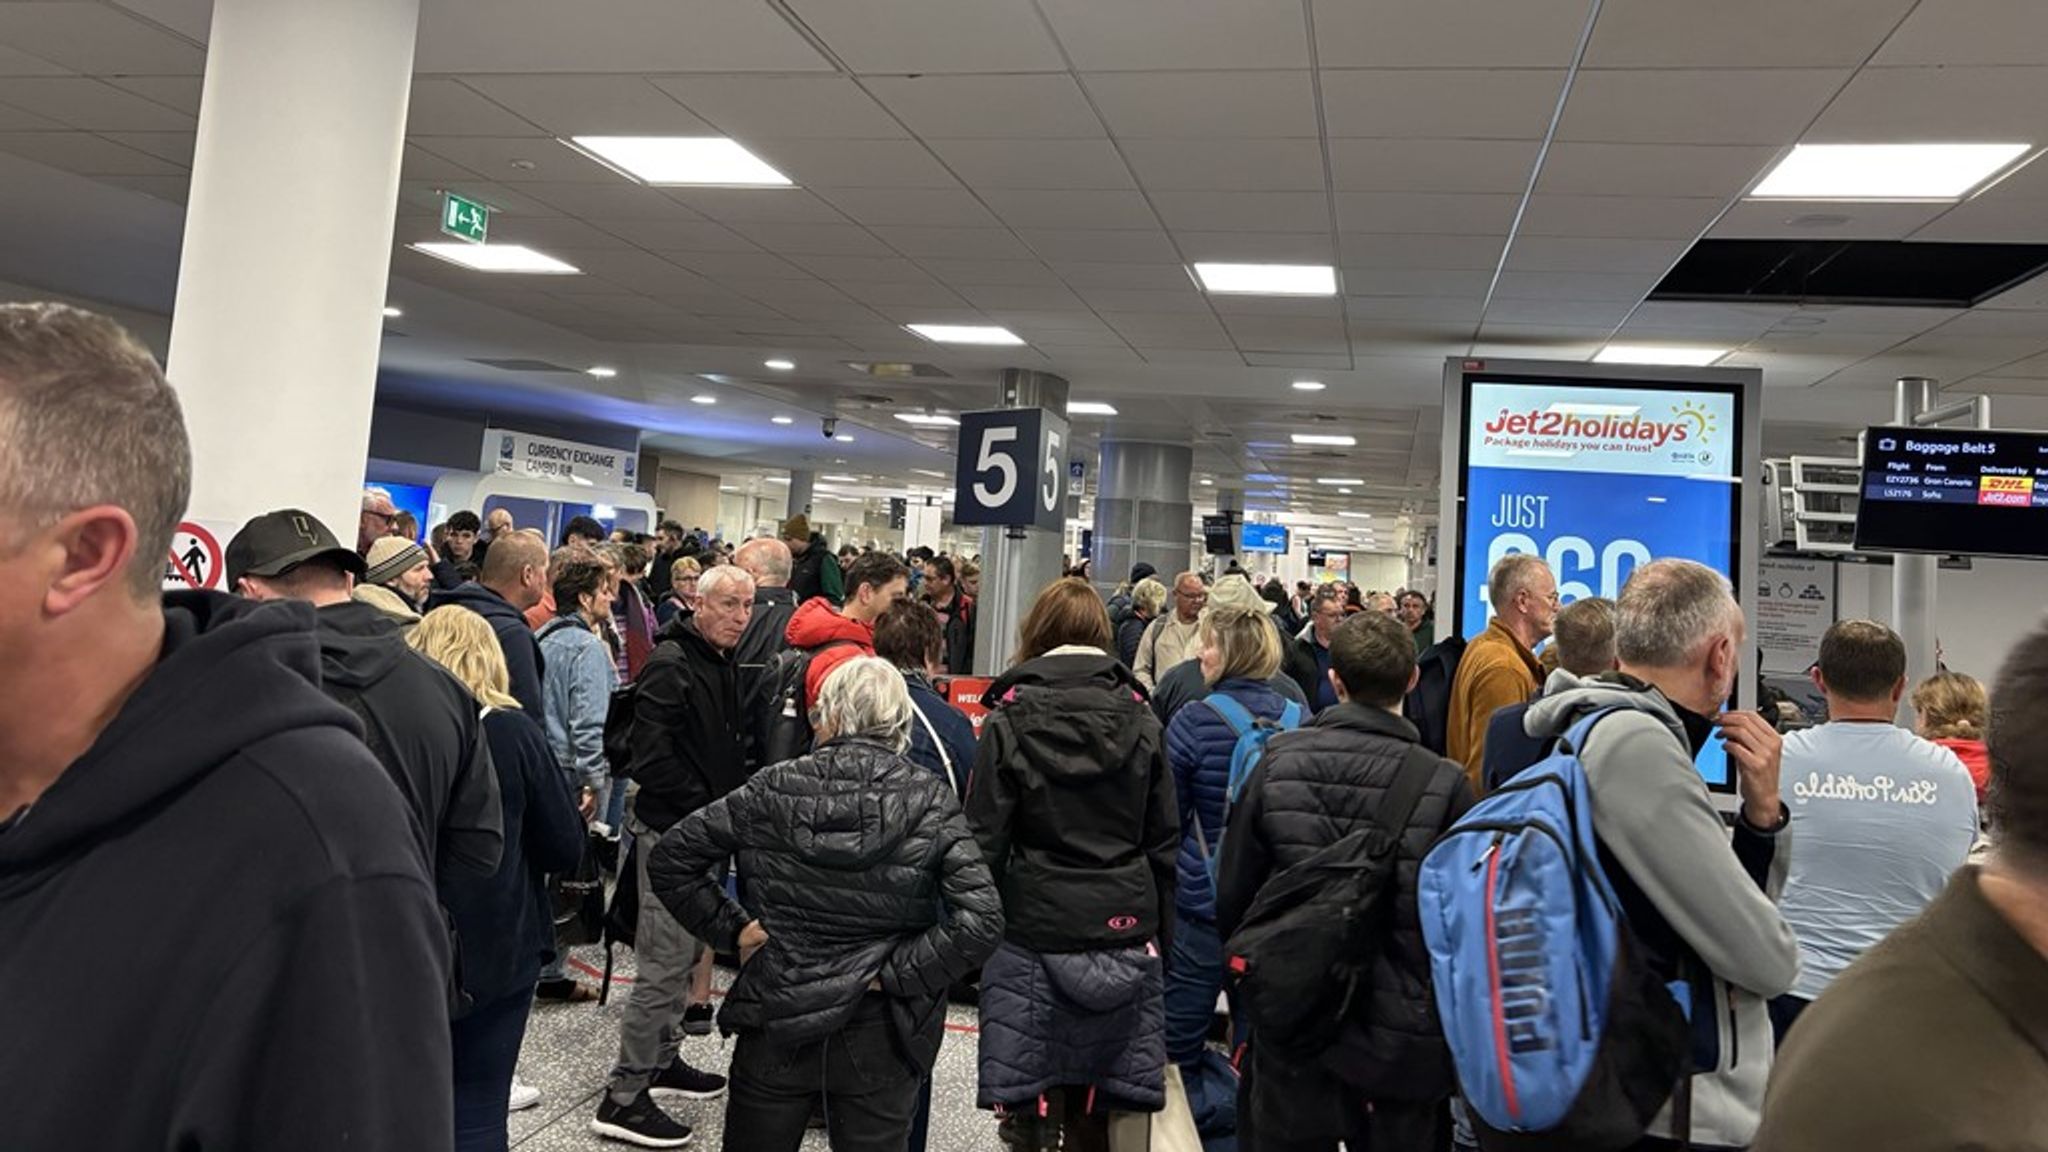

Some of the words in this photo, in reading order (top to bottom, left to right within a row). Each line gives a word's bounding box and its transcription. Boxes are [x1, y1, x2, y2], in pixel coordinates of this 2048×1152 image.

[1485, 408, 1688, 447] Jet2holidays
[528, 442, 573, 461] CURRENCY
[573, 449, 615, 469] EXCHANGE
[1484, 436, 1530, 449] Package
[1532, 439, 1577, 451] holidays
[1579, 442, 1601, 452] you
[1602, 444, 1623, 452] can
[1625, 443, 1652, 453] trust
[1906, 440, 1960, 455] Baggage
[1962, 442, 1987, 454] Belt
[1987, 443, 1996, 454] 5
[973, 426, 1017, 507] 5
[1043, 430, 1060, 512] 5
[1888, 462, 1911, 471] Flight
[1925, 463, 1947, 471] From
[1980, 466, 2018, 475] Delivered
[2018, 467, 2028, 476] by
[1988, 478, 2025, 489] DHL
[1491, 493, 1549, 529] JUST
[1496, 907, 1549, 1054] PUMA
